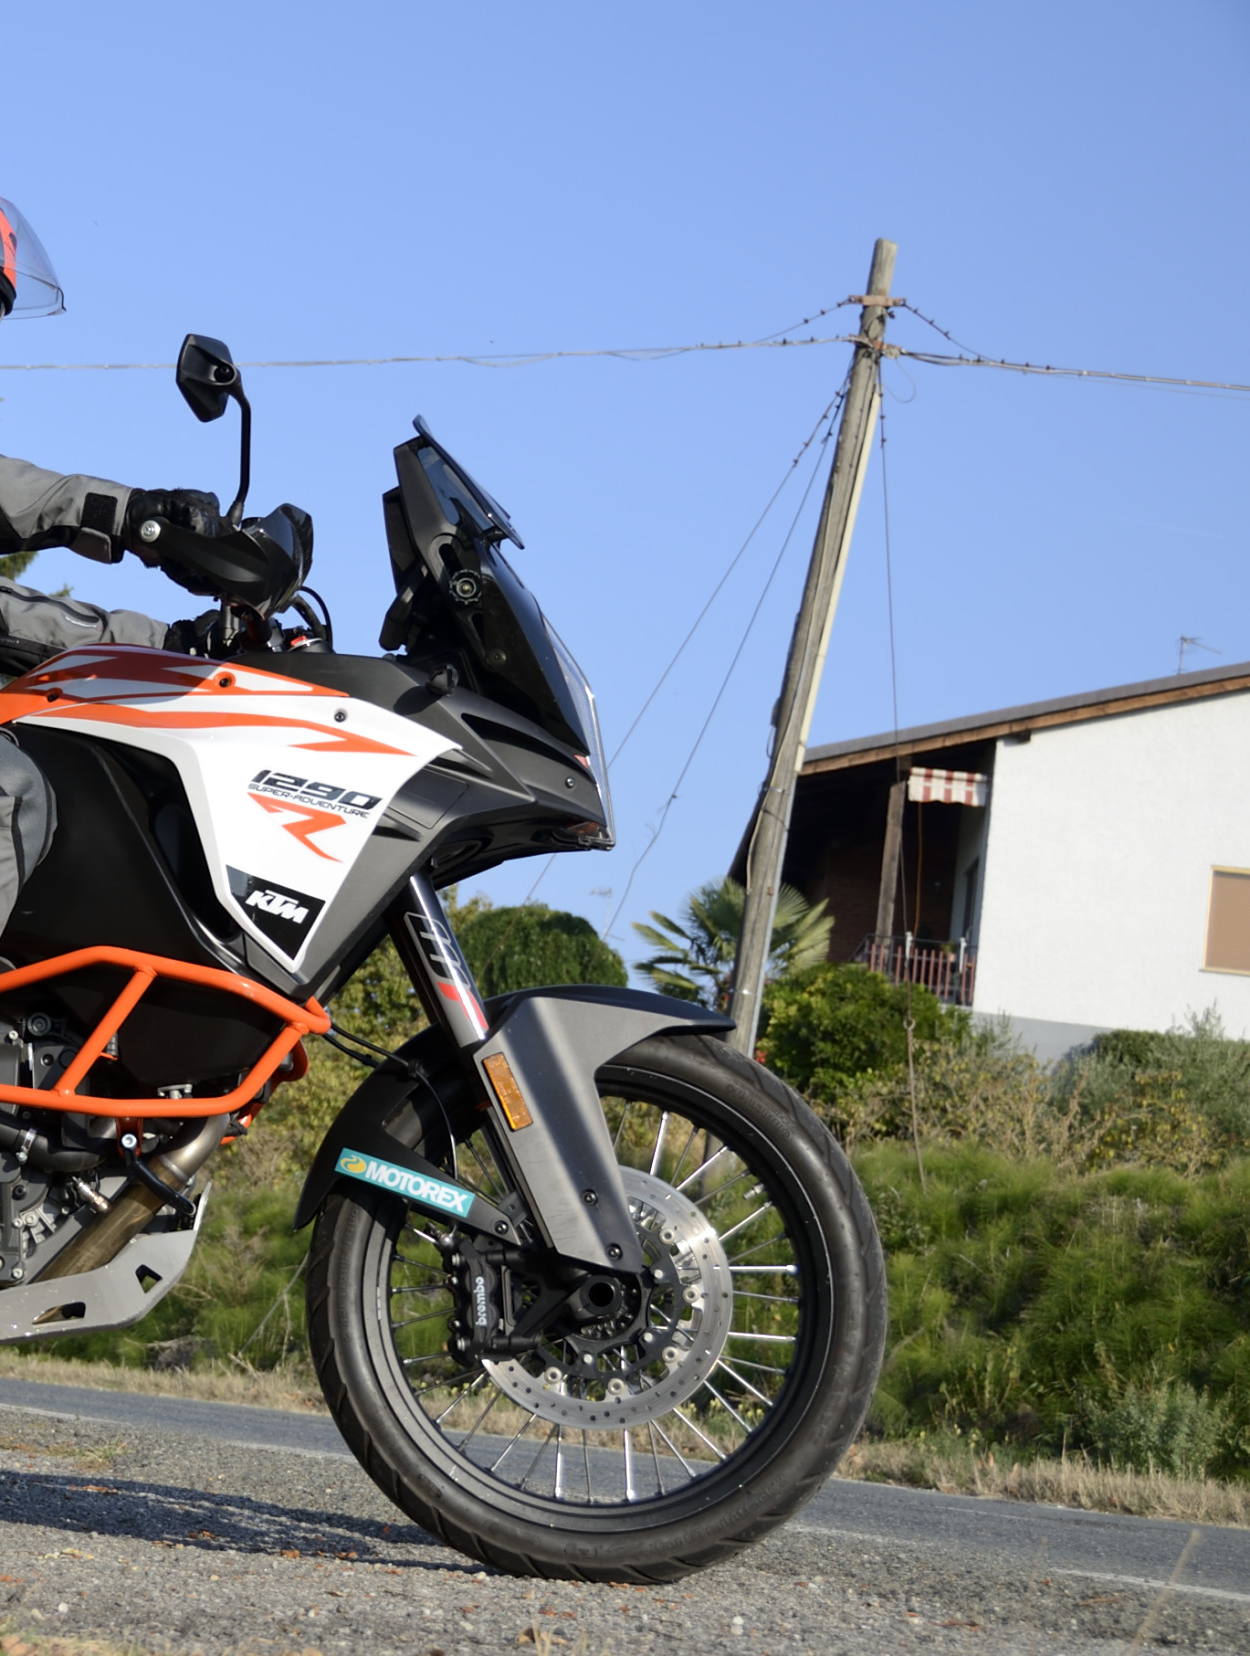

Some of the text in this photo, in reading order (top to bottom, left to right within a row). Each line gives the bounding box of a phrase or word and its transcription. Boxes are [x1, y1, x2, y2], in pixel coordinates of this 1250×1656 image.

[251, 769, 383, 811] 1290
[245, 889, 309, 924] KTM
[365, 1161, 467, 1213] MOTOREX
[473, 1276, 487, 1326] brembo
